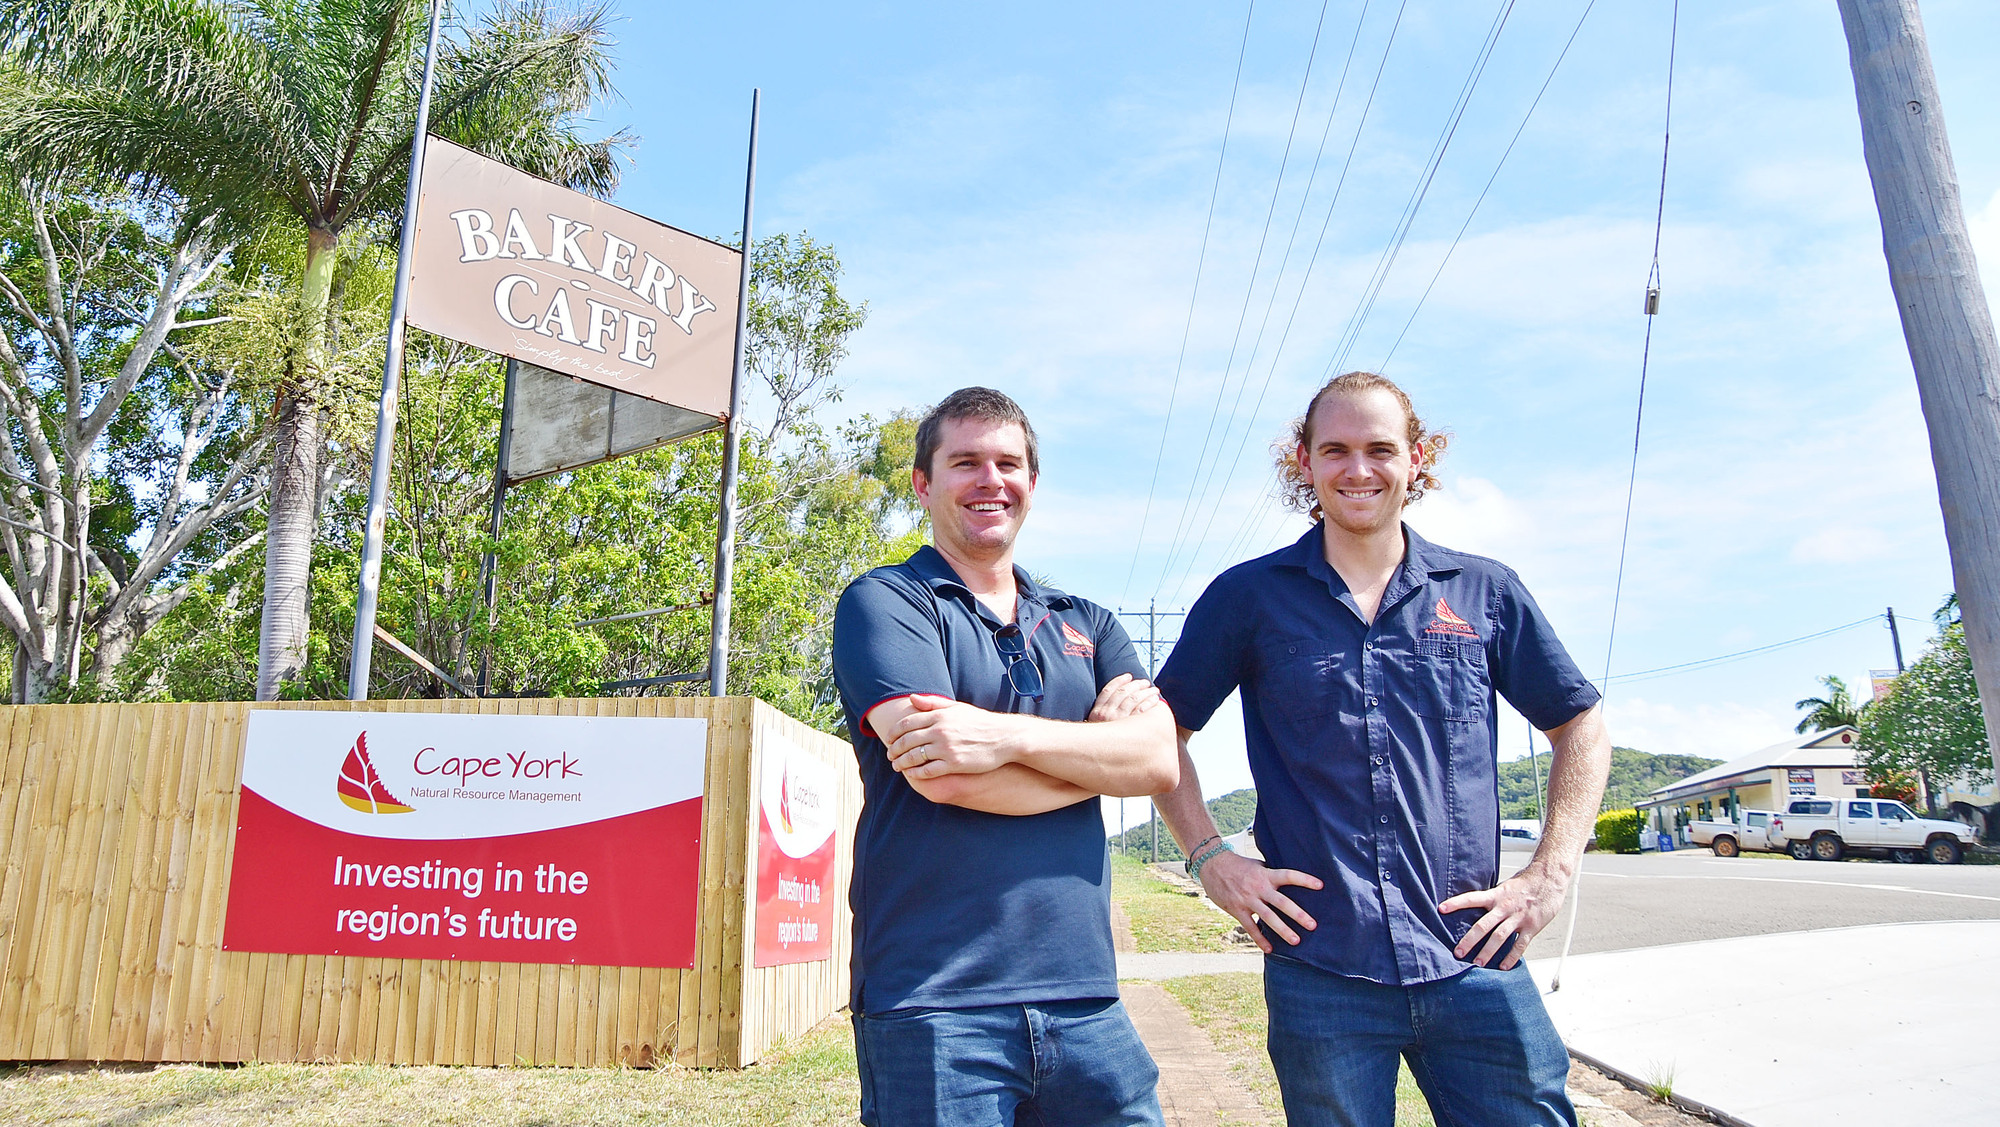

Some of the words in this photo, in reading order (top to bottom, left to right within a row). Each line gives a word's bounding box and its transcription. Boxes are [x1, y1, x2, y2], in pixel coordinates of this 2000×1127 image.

[450, 208, 716, 335] BAKERY
[494, 274, 657, 369] CAFE
[570, 355, 591, 370] the
[1430, 619, 1454, 632] Cape
[1064, 642, 1086, 654] Cape
[413, 747, 502, 788] Cape
[506, 750, 583, 779] York
[410, 786, 450, 799] Natural
[452, 788, 506, 800] Resource
[508, 789, 582, 804] Management
[333, 855, 484, 899] Investing
[494, 861, 523, 893] in
[534, 863, 589, 895] the
[778, 872, 804, 909] Investing
[804, 877, 811, 903] in
[811, 878, 820, 904] the
[336, 904, 467, 942] region's
[477, 908, 578, 942] future
[802, 916, 819, 942] future
